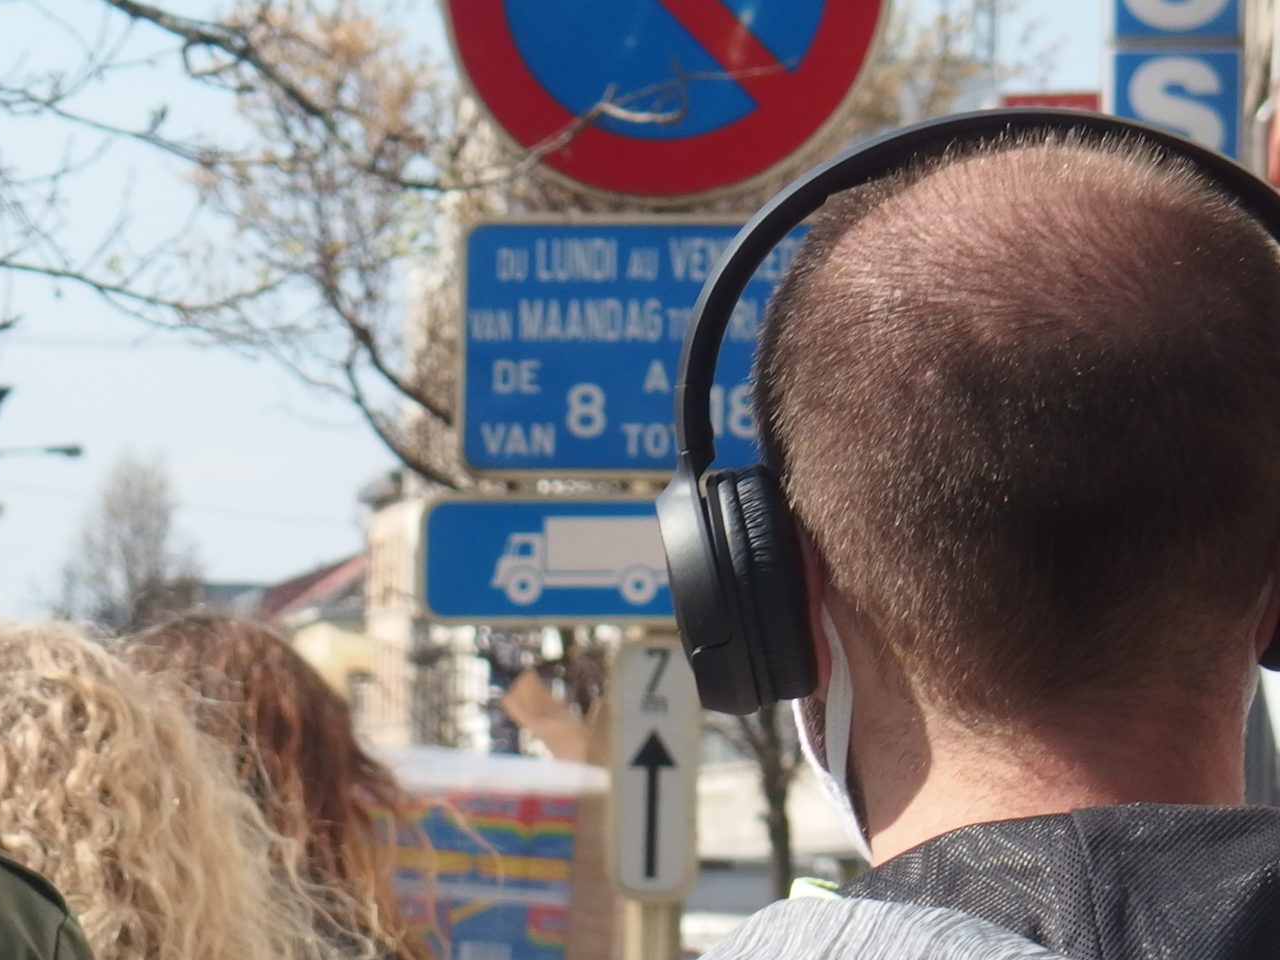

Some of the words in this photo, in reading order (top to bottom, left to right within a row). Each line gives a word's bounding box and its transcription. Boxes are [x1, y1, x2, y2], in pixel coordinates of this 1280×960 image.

[496, 247, 528, 282] DU
[535, 238, 617, 282] LUNDI
[626, 247, 659, 282] AU
[469, 308, 513, 341] VAN
[519, 298, 663, 342] MAANDAG
[491, 359, 542, 394] DE
[642, 359, 670, 394] A
[565, 382, 608, 439] 8
[480, 422, 556, 458] VAN
[621, 422, 676, 458] TO
